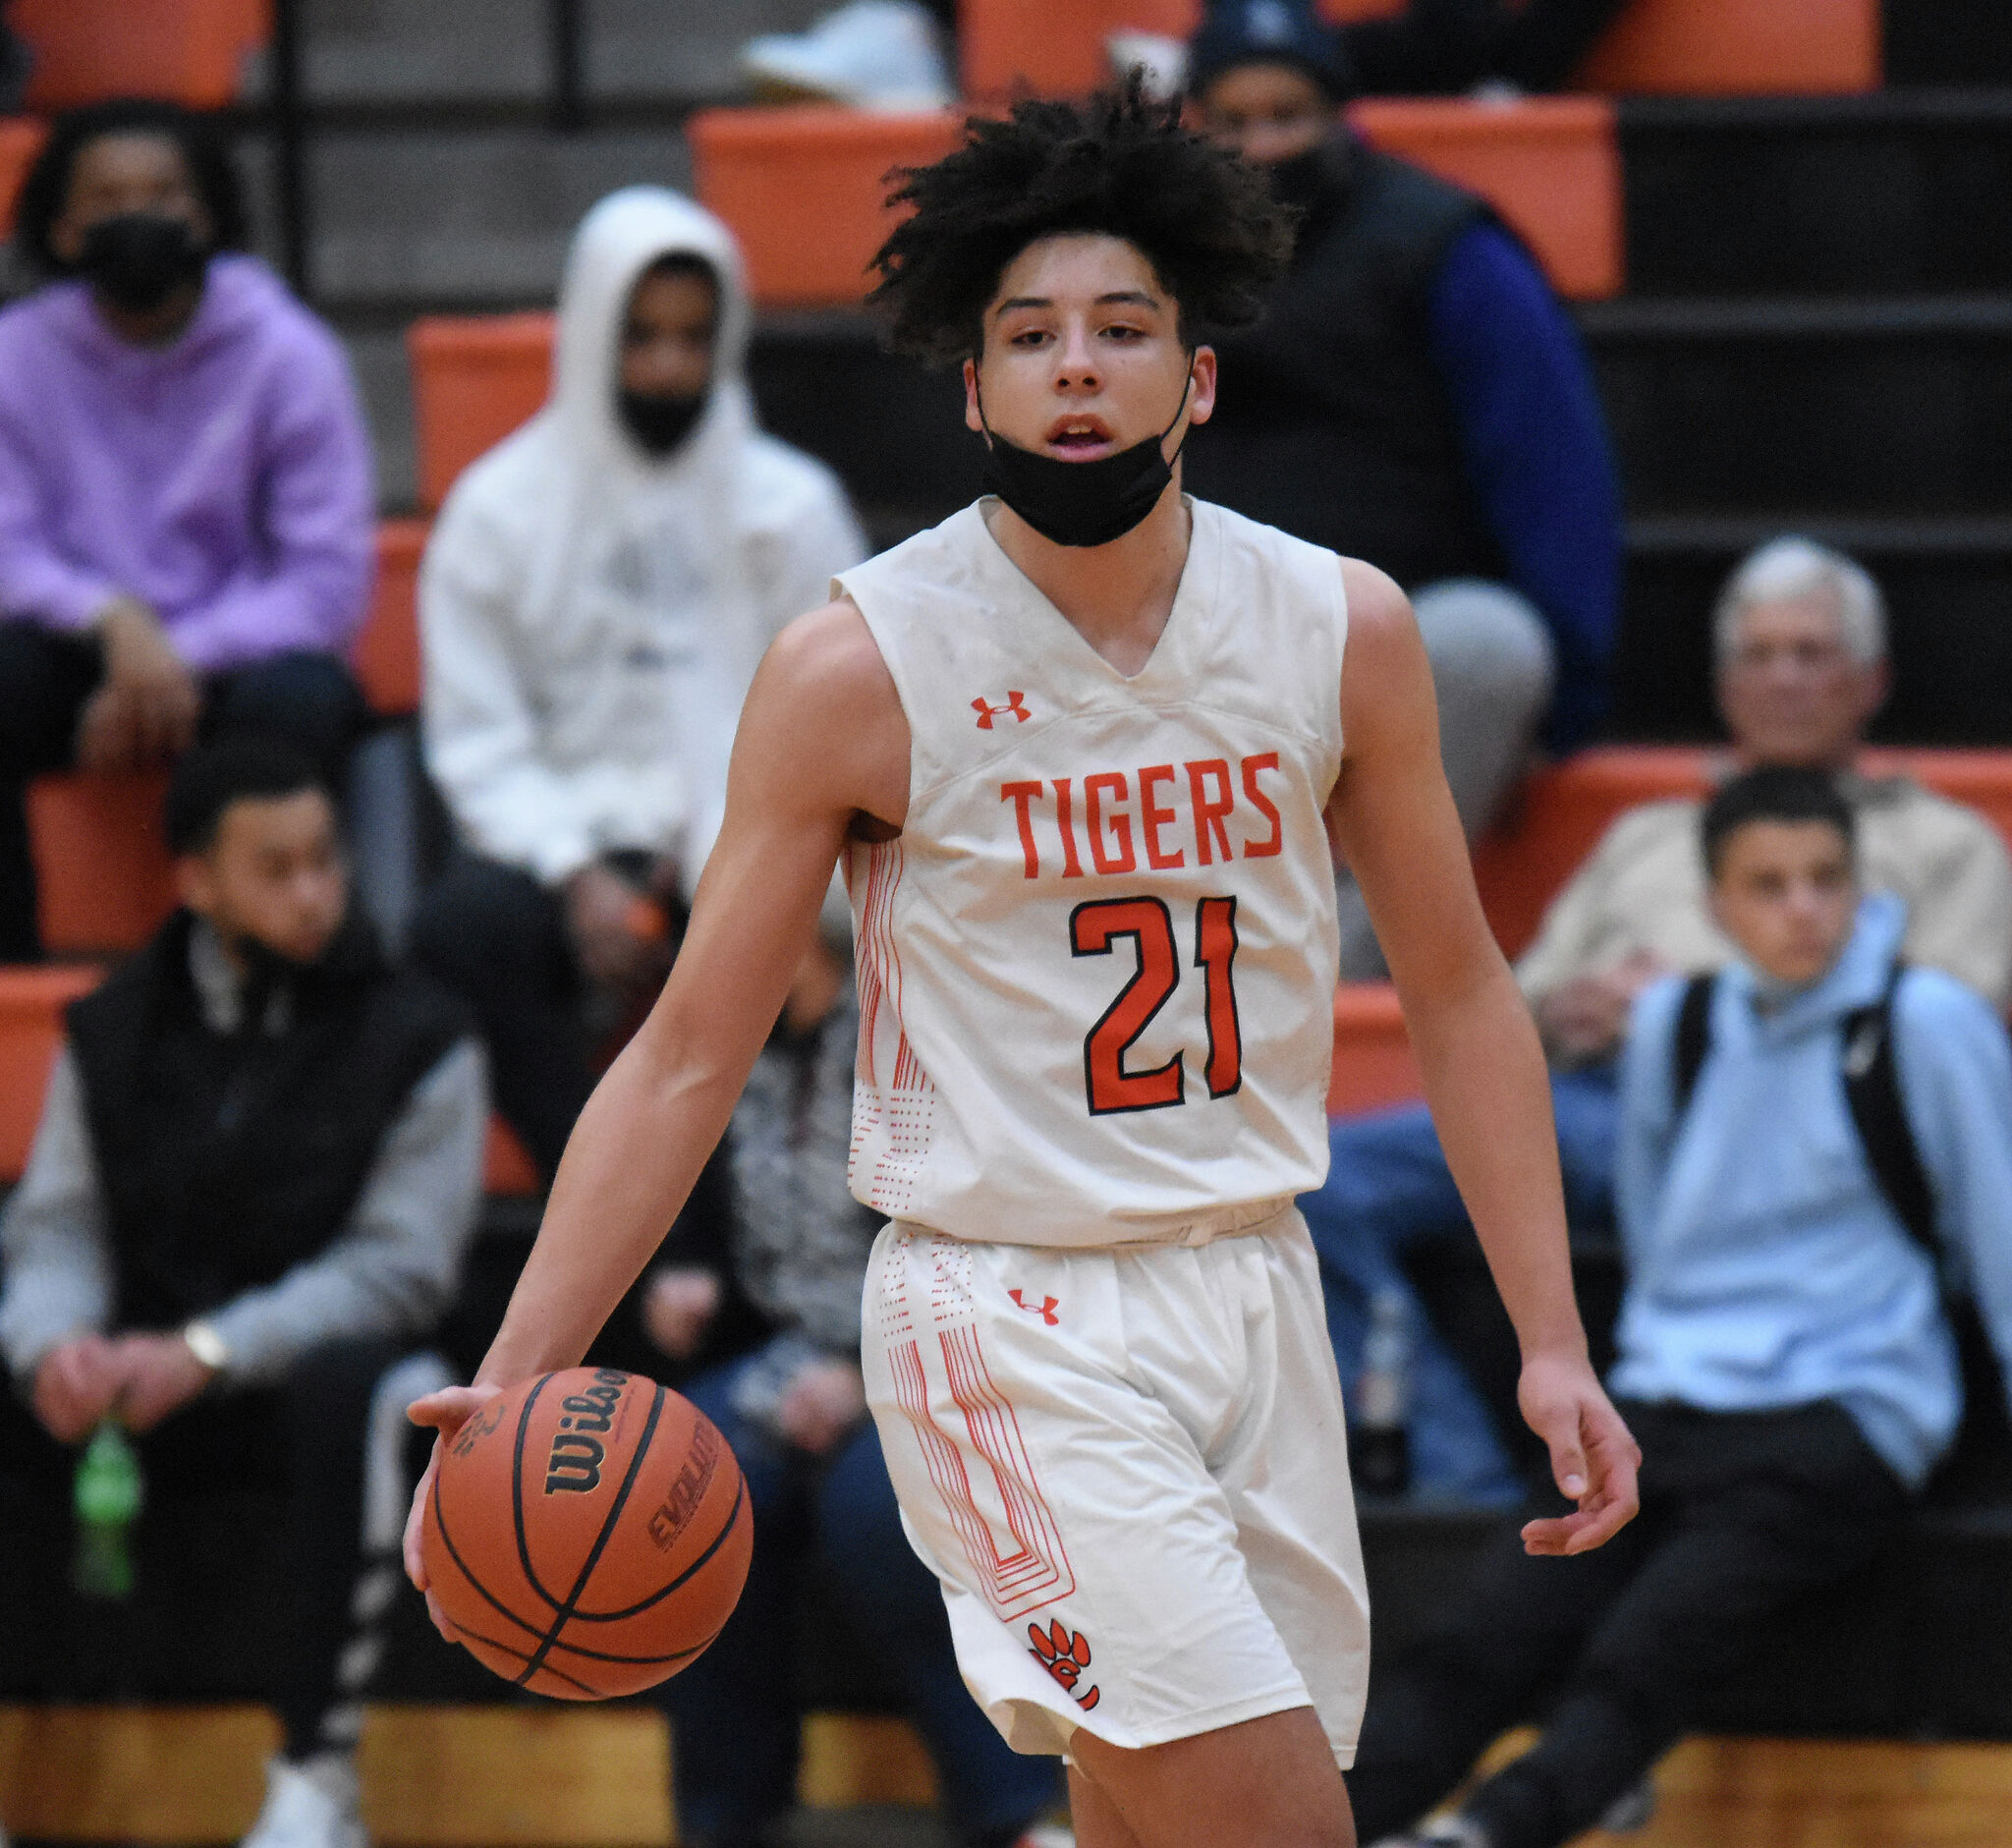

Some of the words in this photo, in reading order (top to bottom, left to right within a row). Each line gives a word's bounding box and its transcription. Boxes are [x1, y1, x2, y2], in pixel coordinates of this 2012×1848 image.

[1000, 752, 1282, 879] TIGERS
[1069, 895, 1242, 1116] 21
[543, 1367, 628, 1495] Wilso
